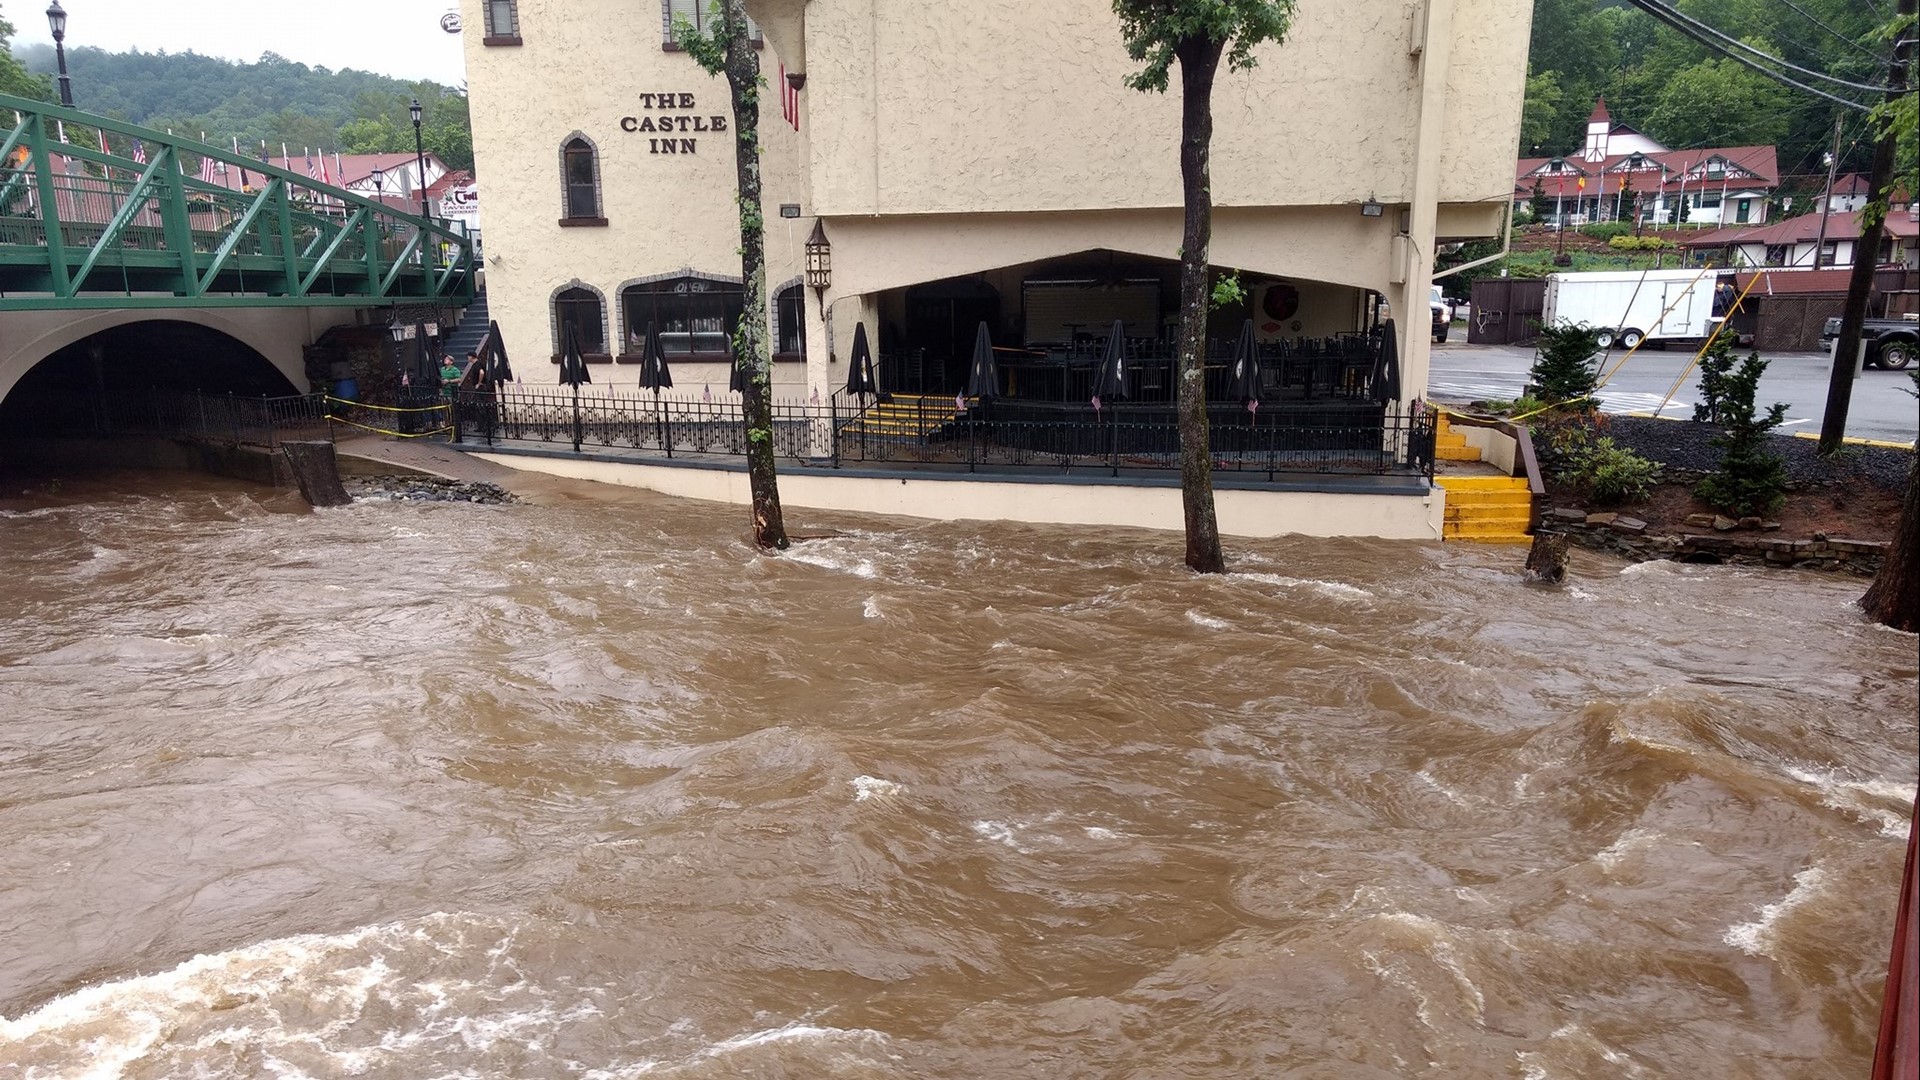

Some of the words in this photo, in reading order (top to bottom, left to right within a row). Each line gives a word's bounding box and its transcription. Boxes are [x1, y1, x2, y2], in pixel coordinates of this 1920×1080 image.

[639, 92, 696, 109] THE
[620, 115, 728, 133] CASTLE
[649, 138, 697, 154] INN
[454, 190, 478, 205] Troll
[676, 282, 706, 293] OPEN
